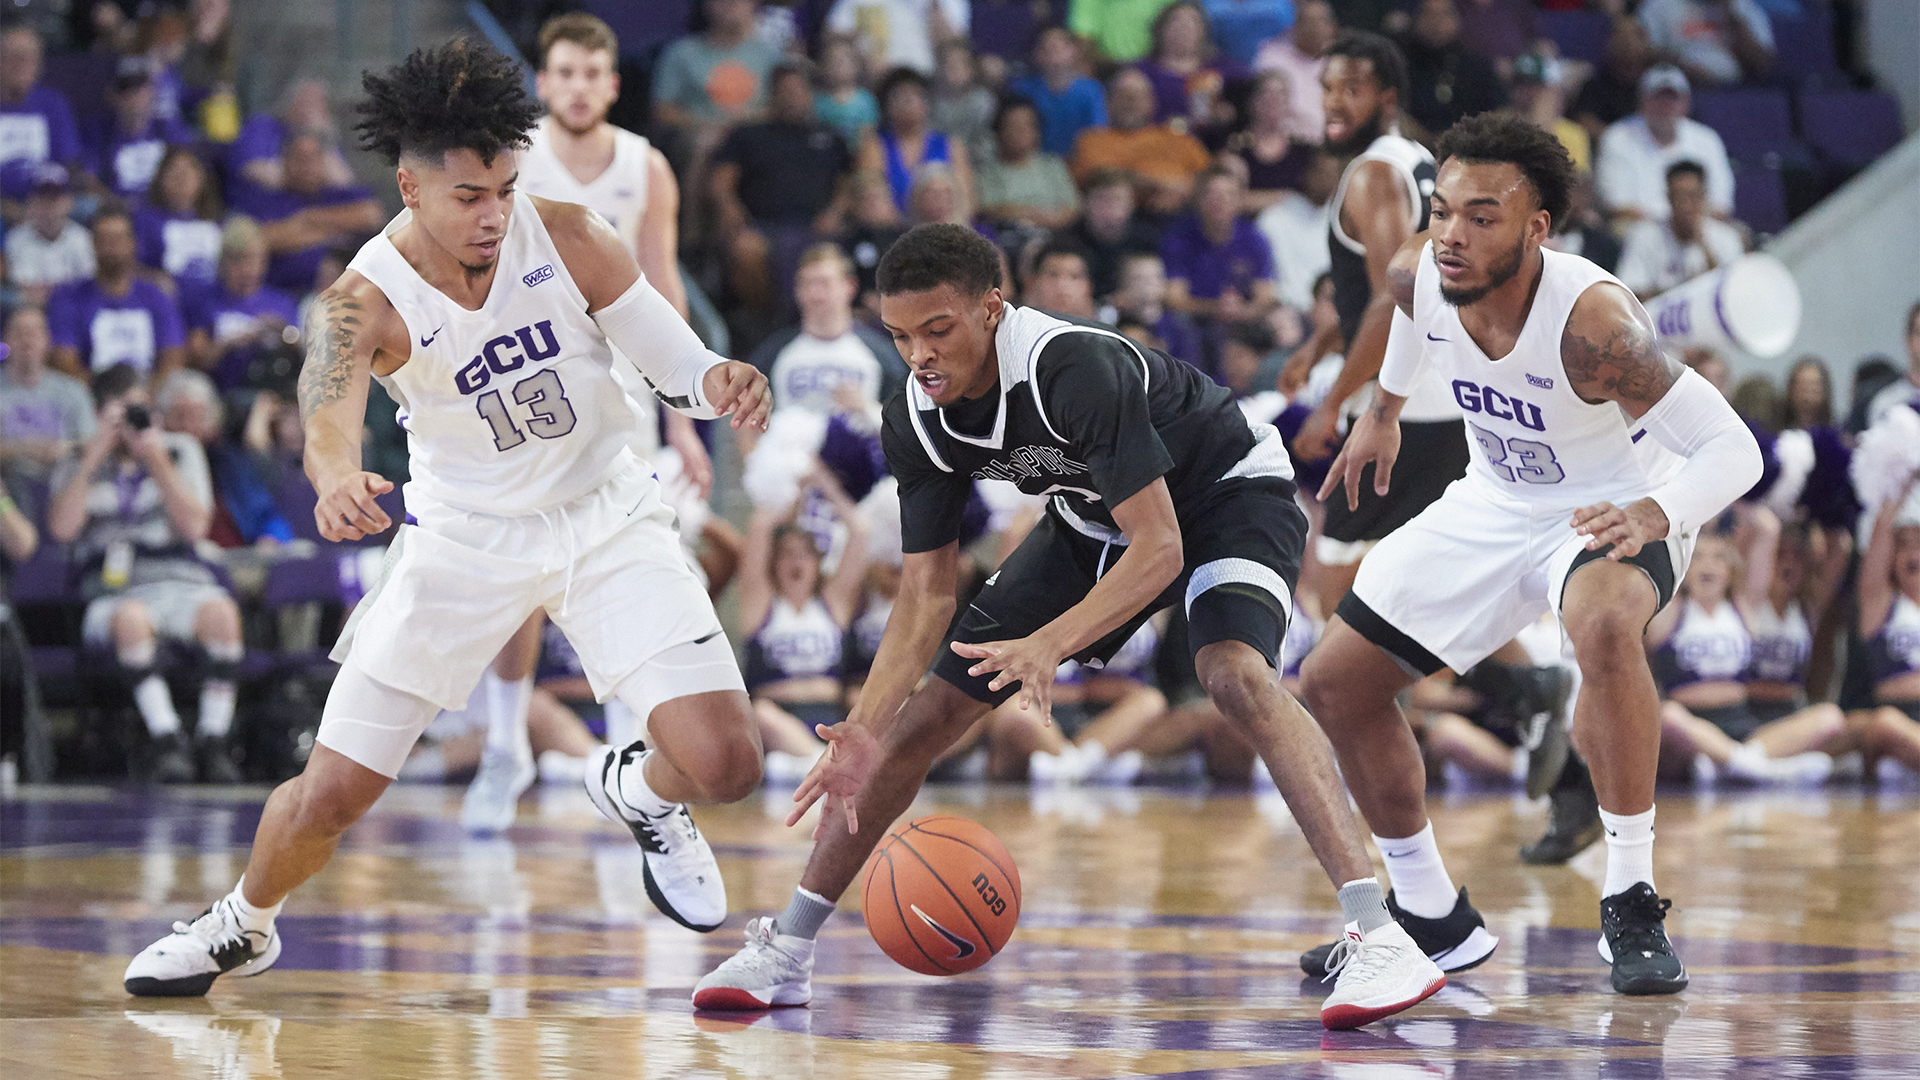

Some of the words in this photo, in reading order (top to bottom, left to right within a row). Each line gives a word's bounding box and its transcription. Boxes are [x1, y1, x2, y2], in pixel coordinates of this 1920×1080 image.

[523, 265, 554, 287] WAC
[454, 320, 561, 395] GCU
[1525, 373, 1553, 389] WAC
[476, 368, 577, 452] 13
[1452, 379, 1546, 432] GCU
[1469, 420, 1565, 484] 23
[972, 873, 1006, 917] GCU
